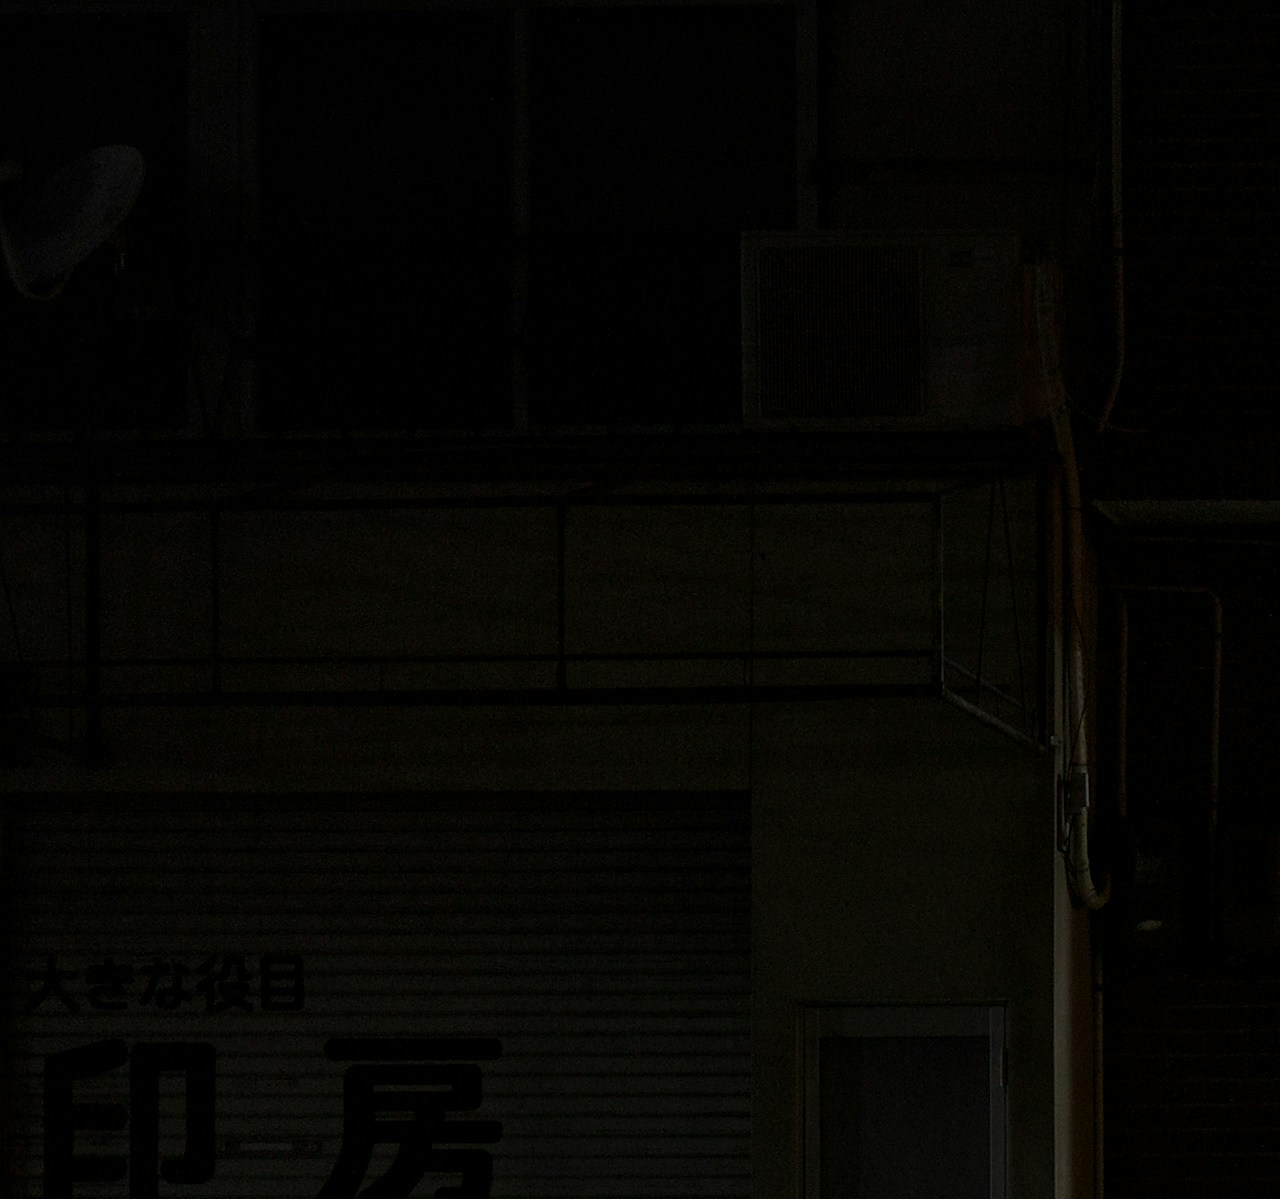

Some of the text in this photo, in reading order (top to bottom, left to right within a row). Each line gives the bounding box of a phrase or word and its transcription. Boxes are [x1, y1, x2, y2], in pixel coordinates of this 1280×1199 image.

[24, 953, 304, 1013] 大きな役目
